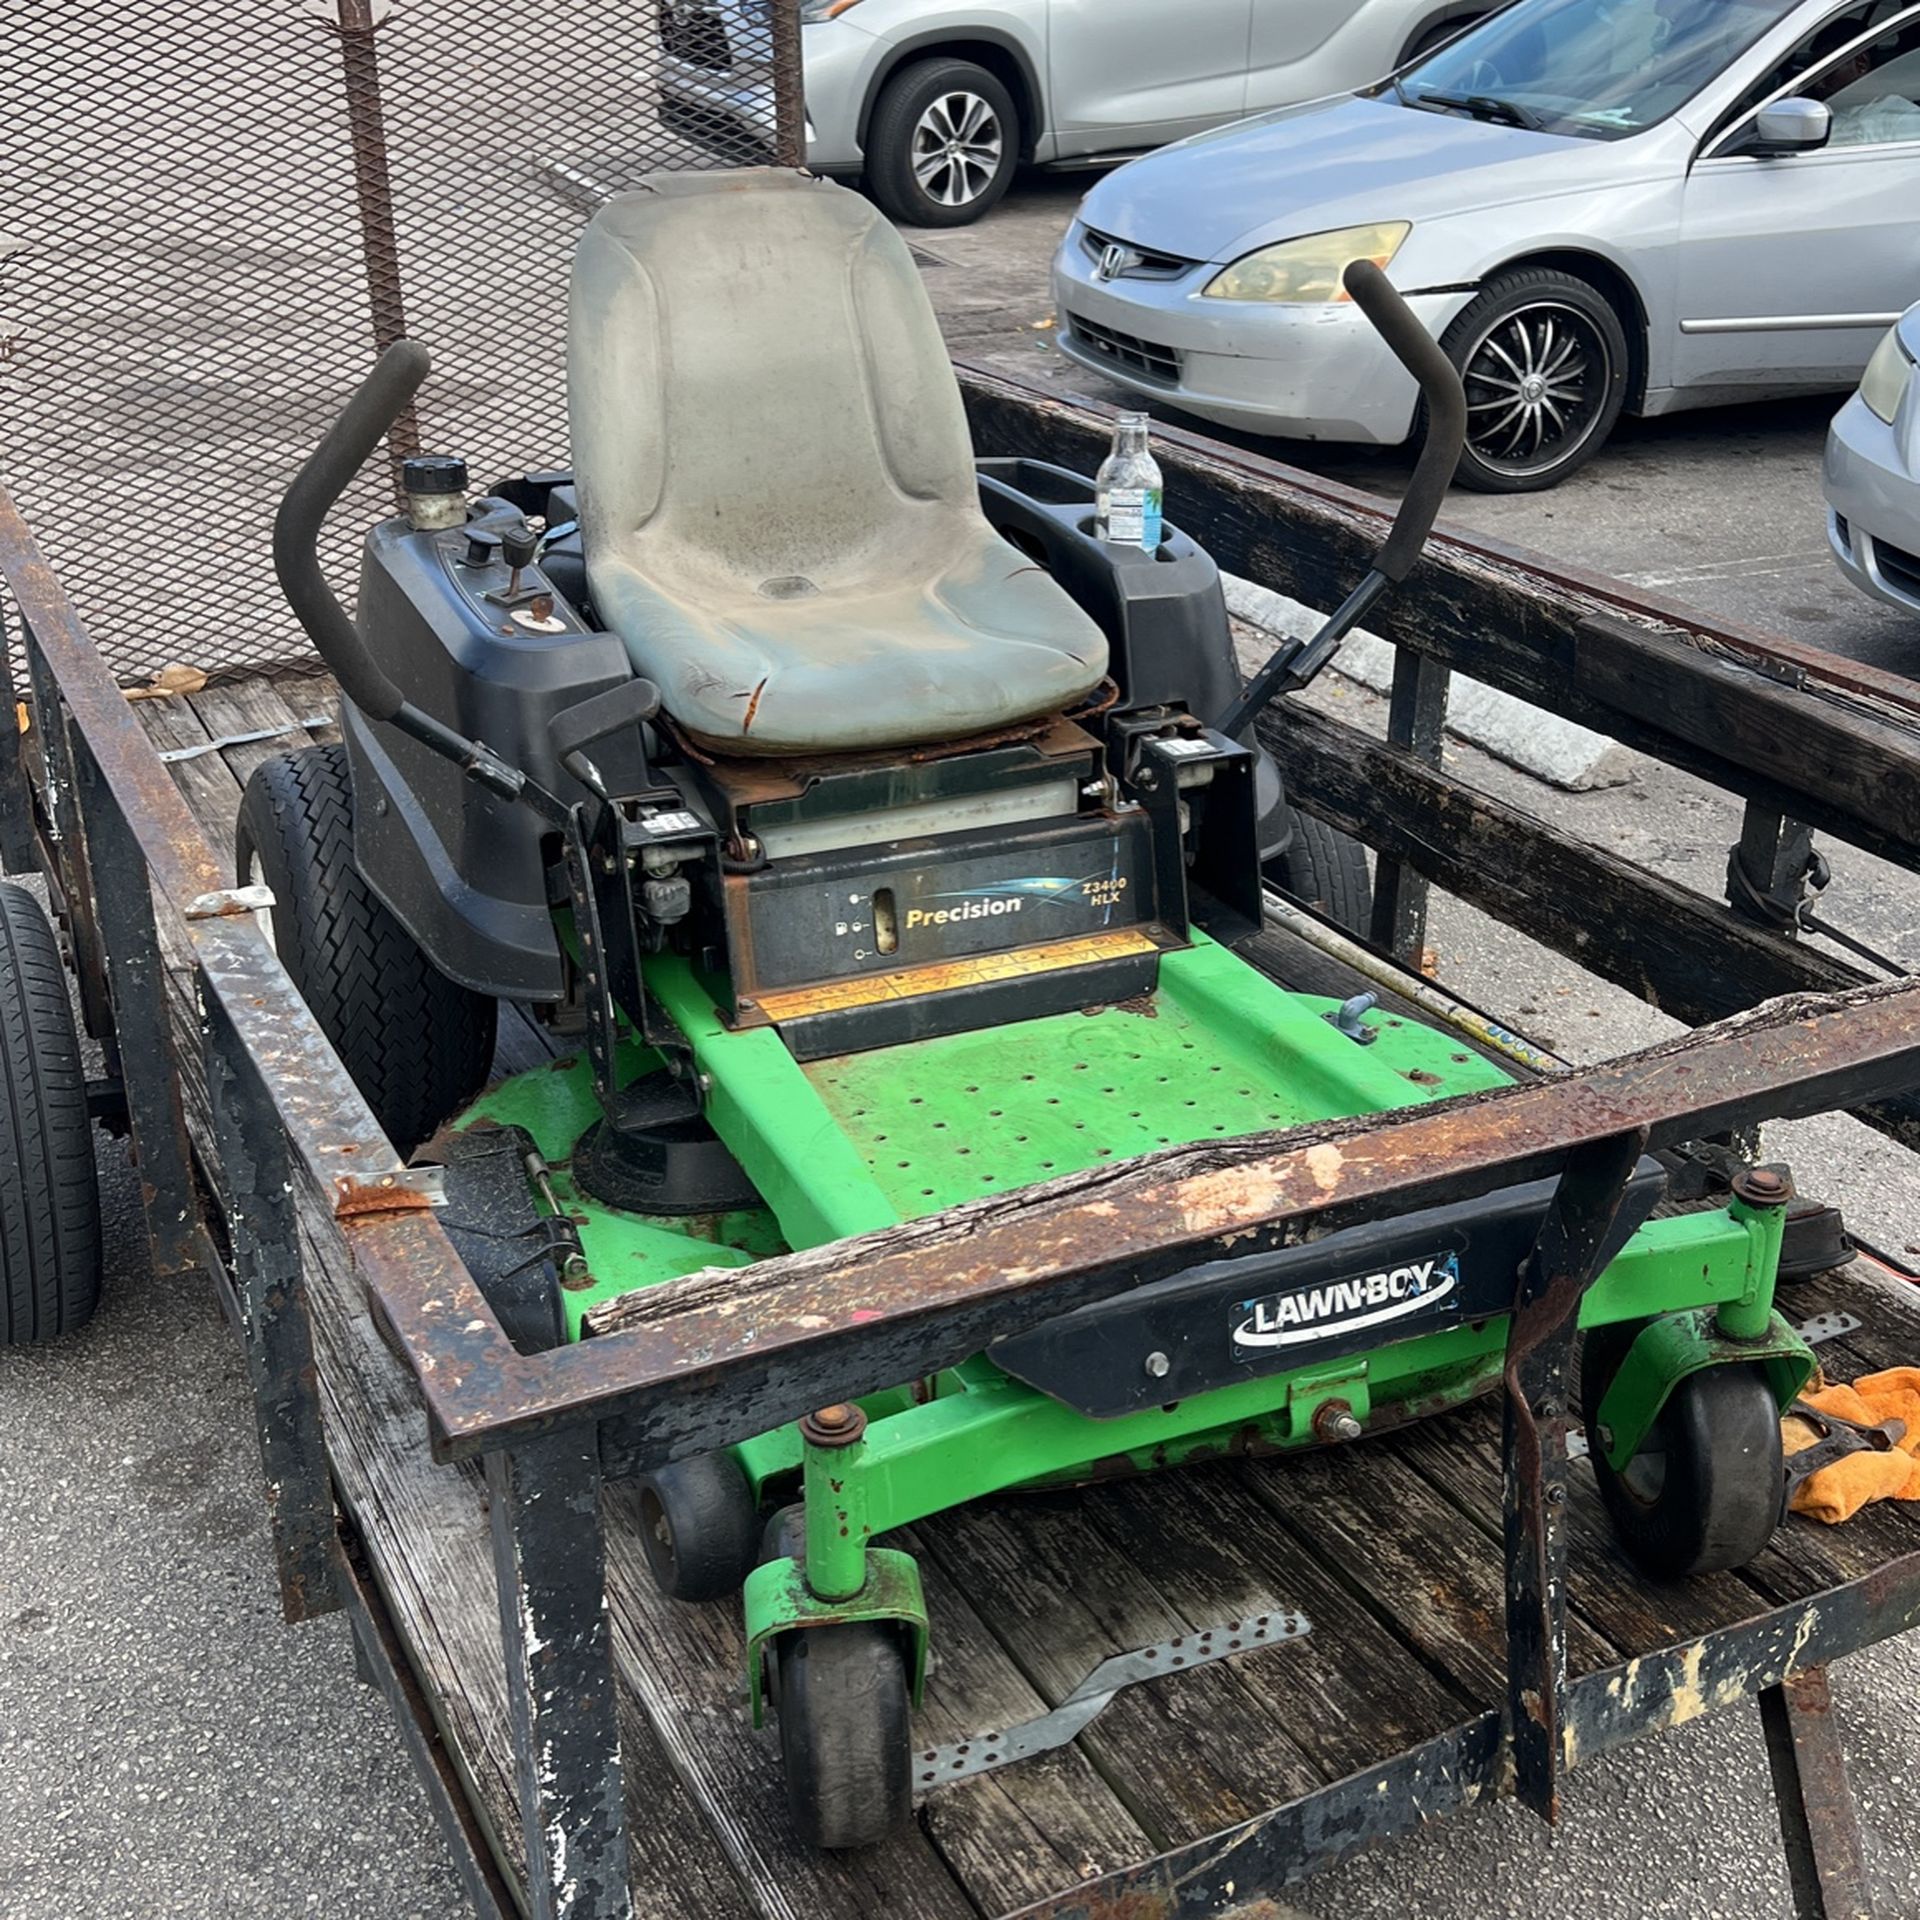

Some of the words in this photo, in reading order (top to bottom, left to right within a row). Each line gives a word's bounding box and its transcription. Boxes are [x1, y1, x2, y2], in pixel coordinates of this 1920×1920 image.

[1081, 876, 1127, 895] Z3400
[1091, 890, 1120, 906] HLX
[906, 897, 1021, 929] Precision
